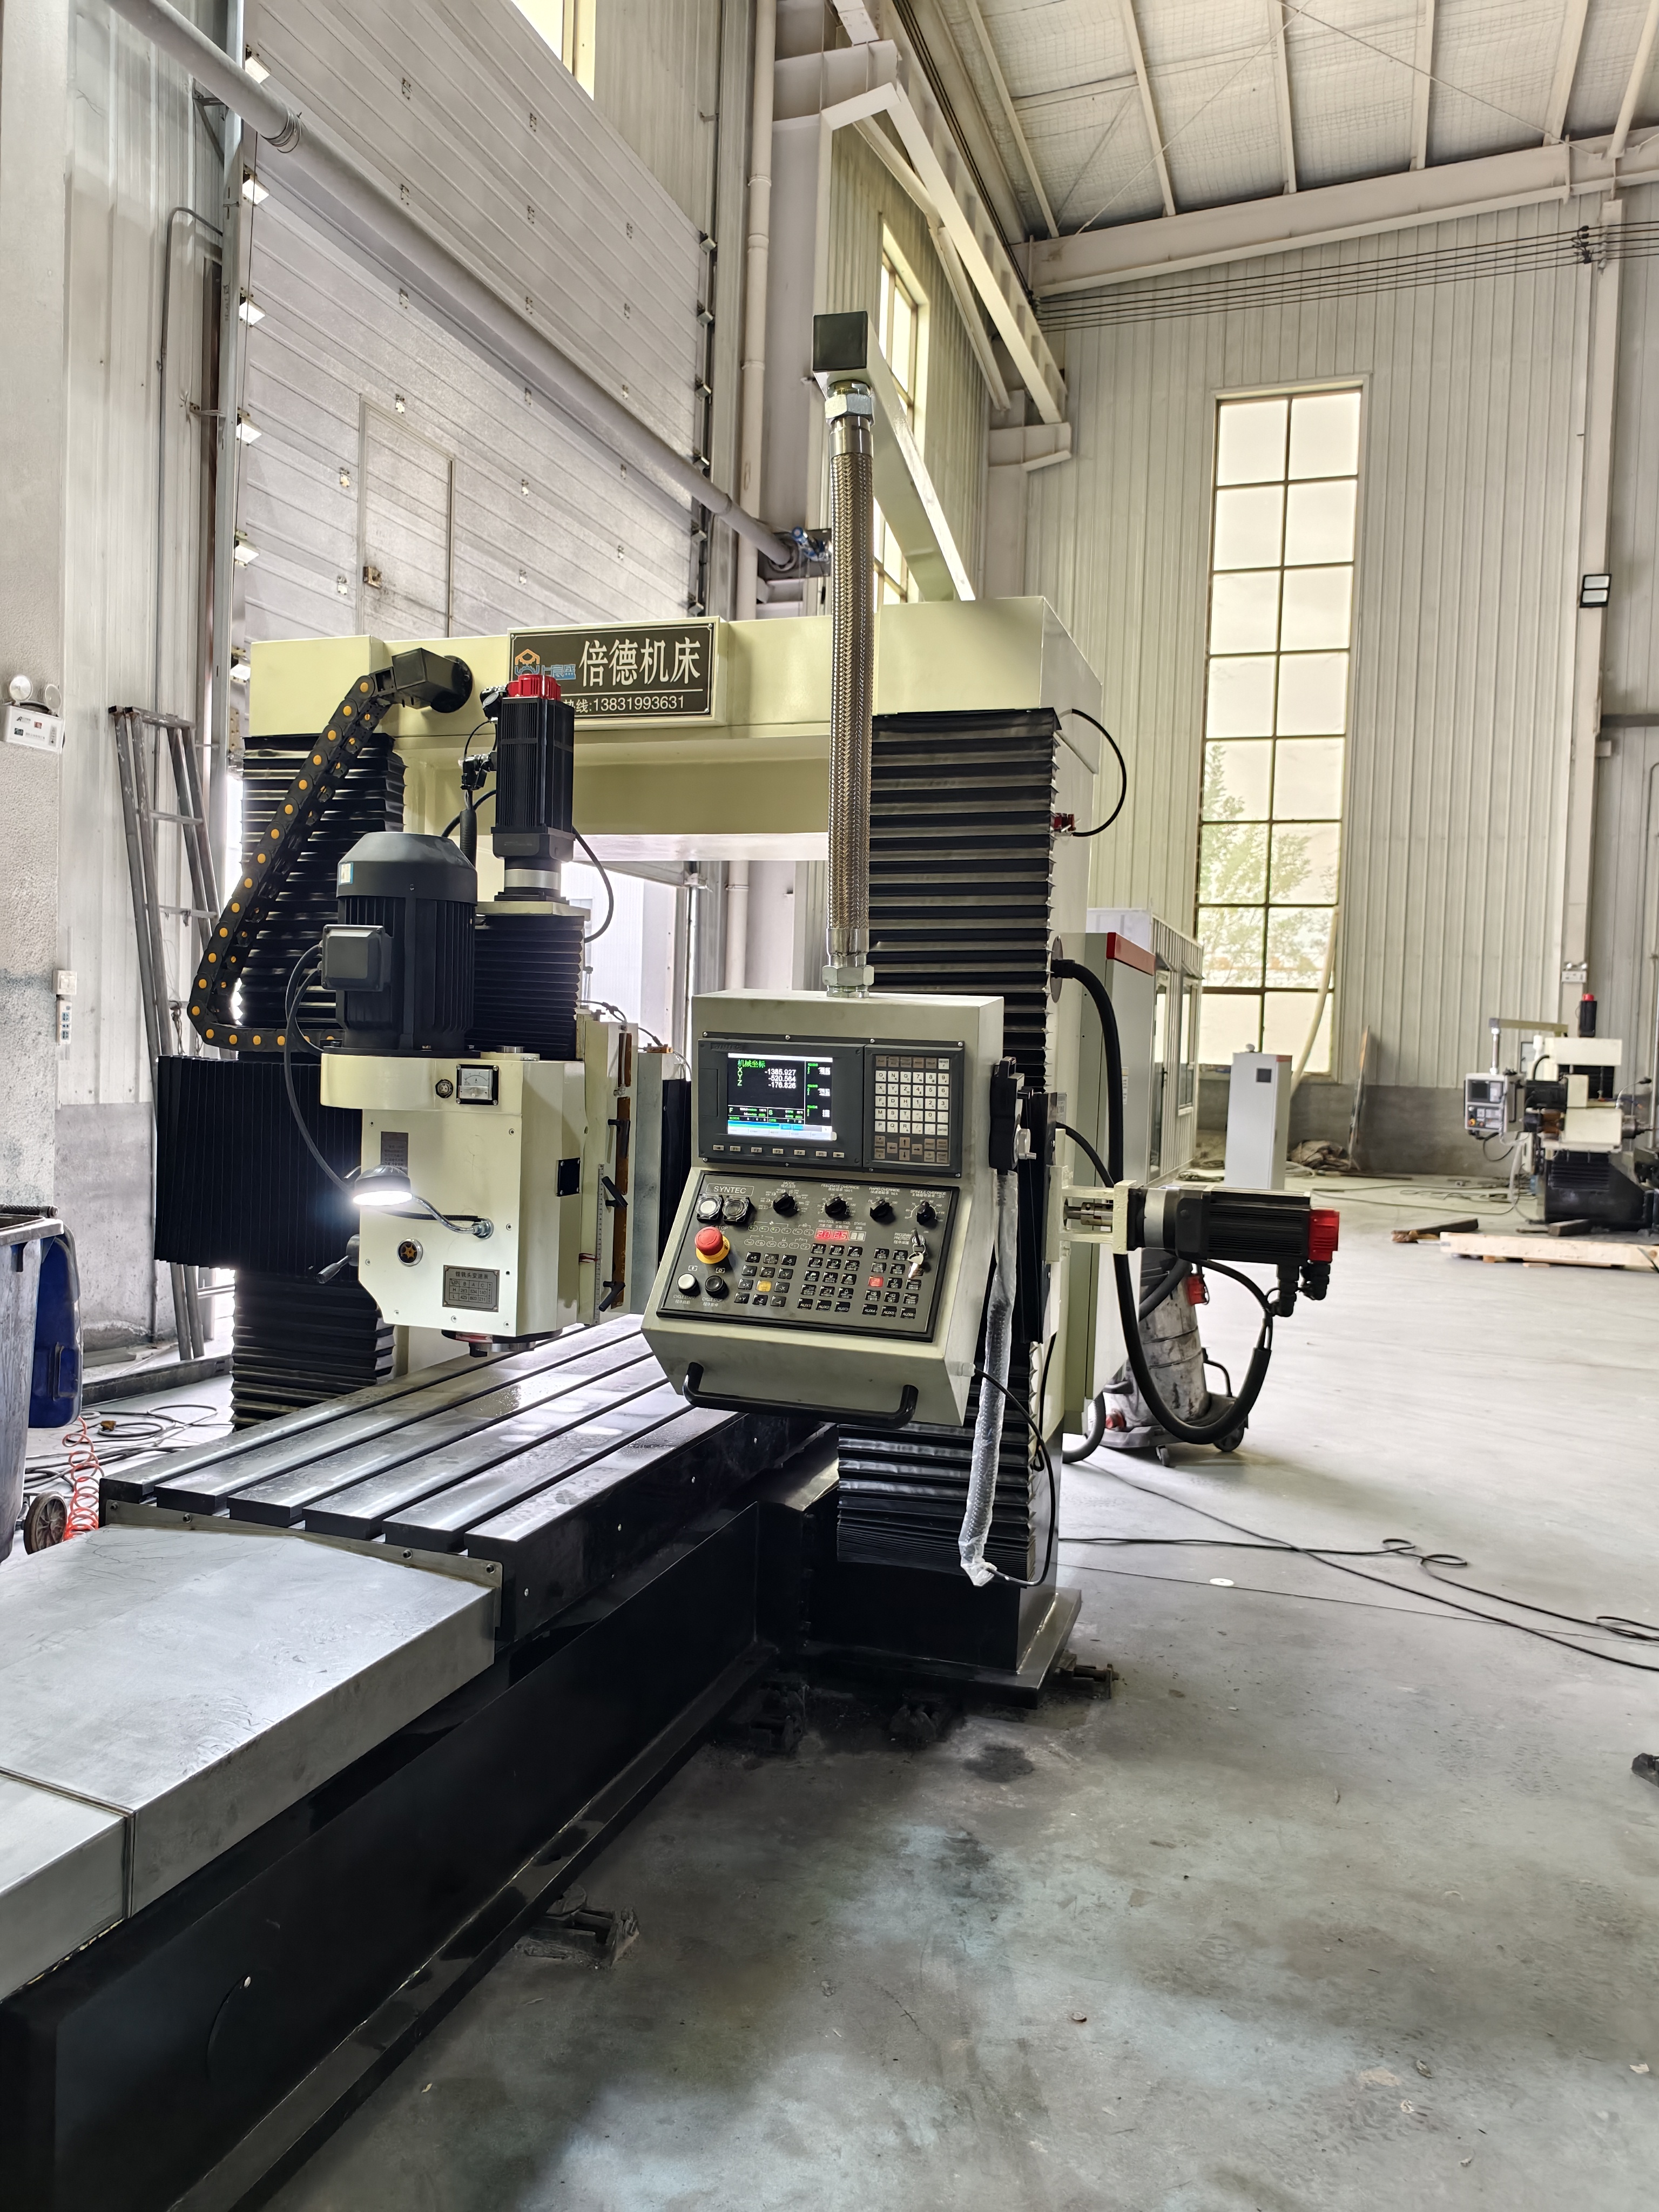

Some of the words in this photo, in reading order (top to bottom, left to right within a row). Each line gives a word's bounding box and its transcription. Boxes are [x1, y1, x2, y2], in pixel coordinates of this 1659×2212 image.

[579, 636, 701, 687] 倍德机床
[737, 1059, 766, 1068] 机械坐标
[834, 1231, 847, 1239] 25
